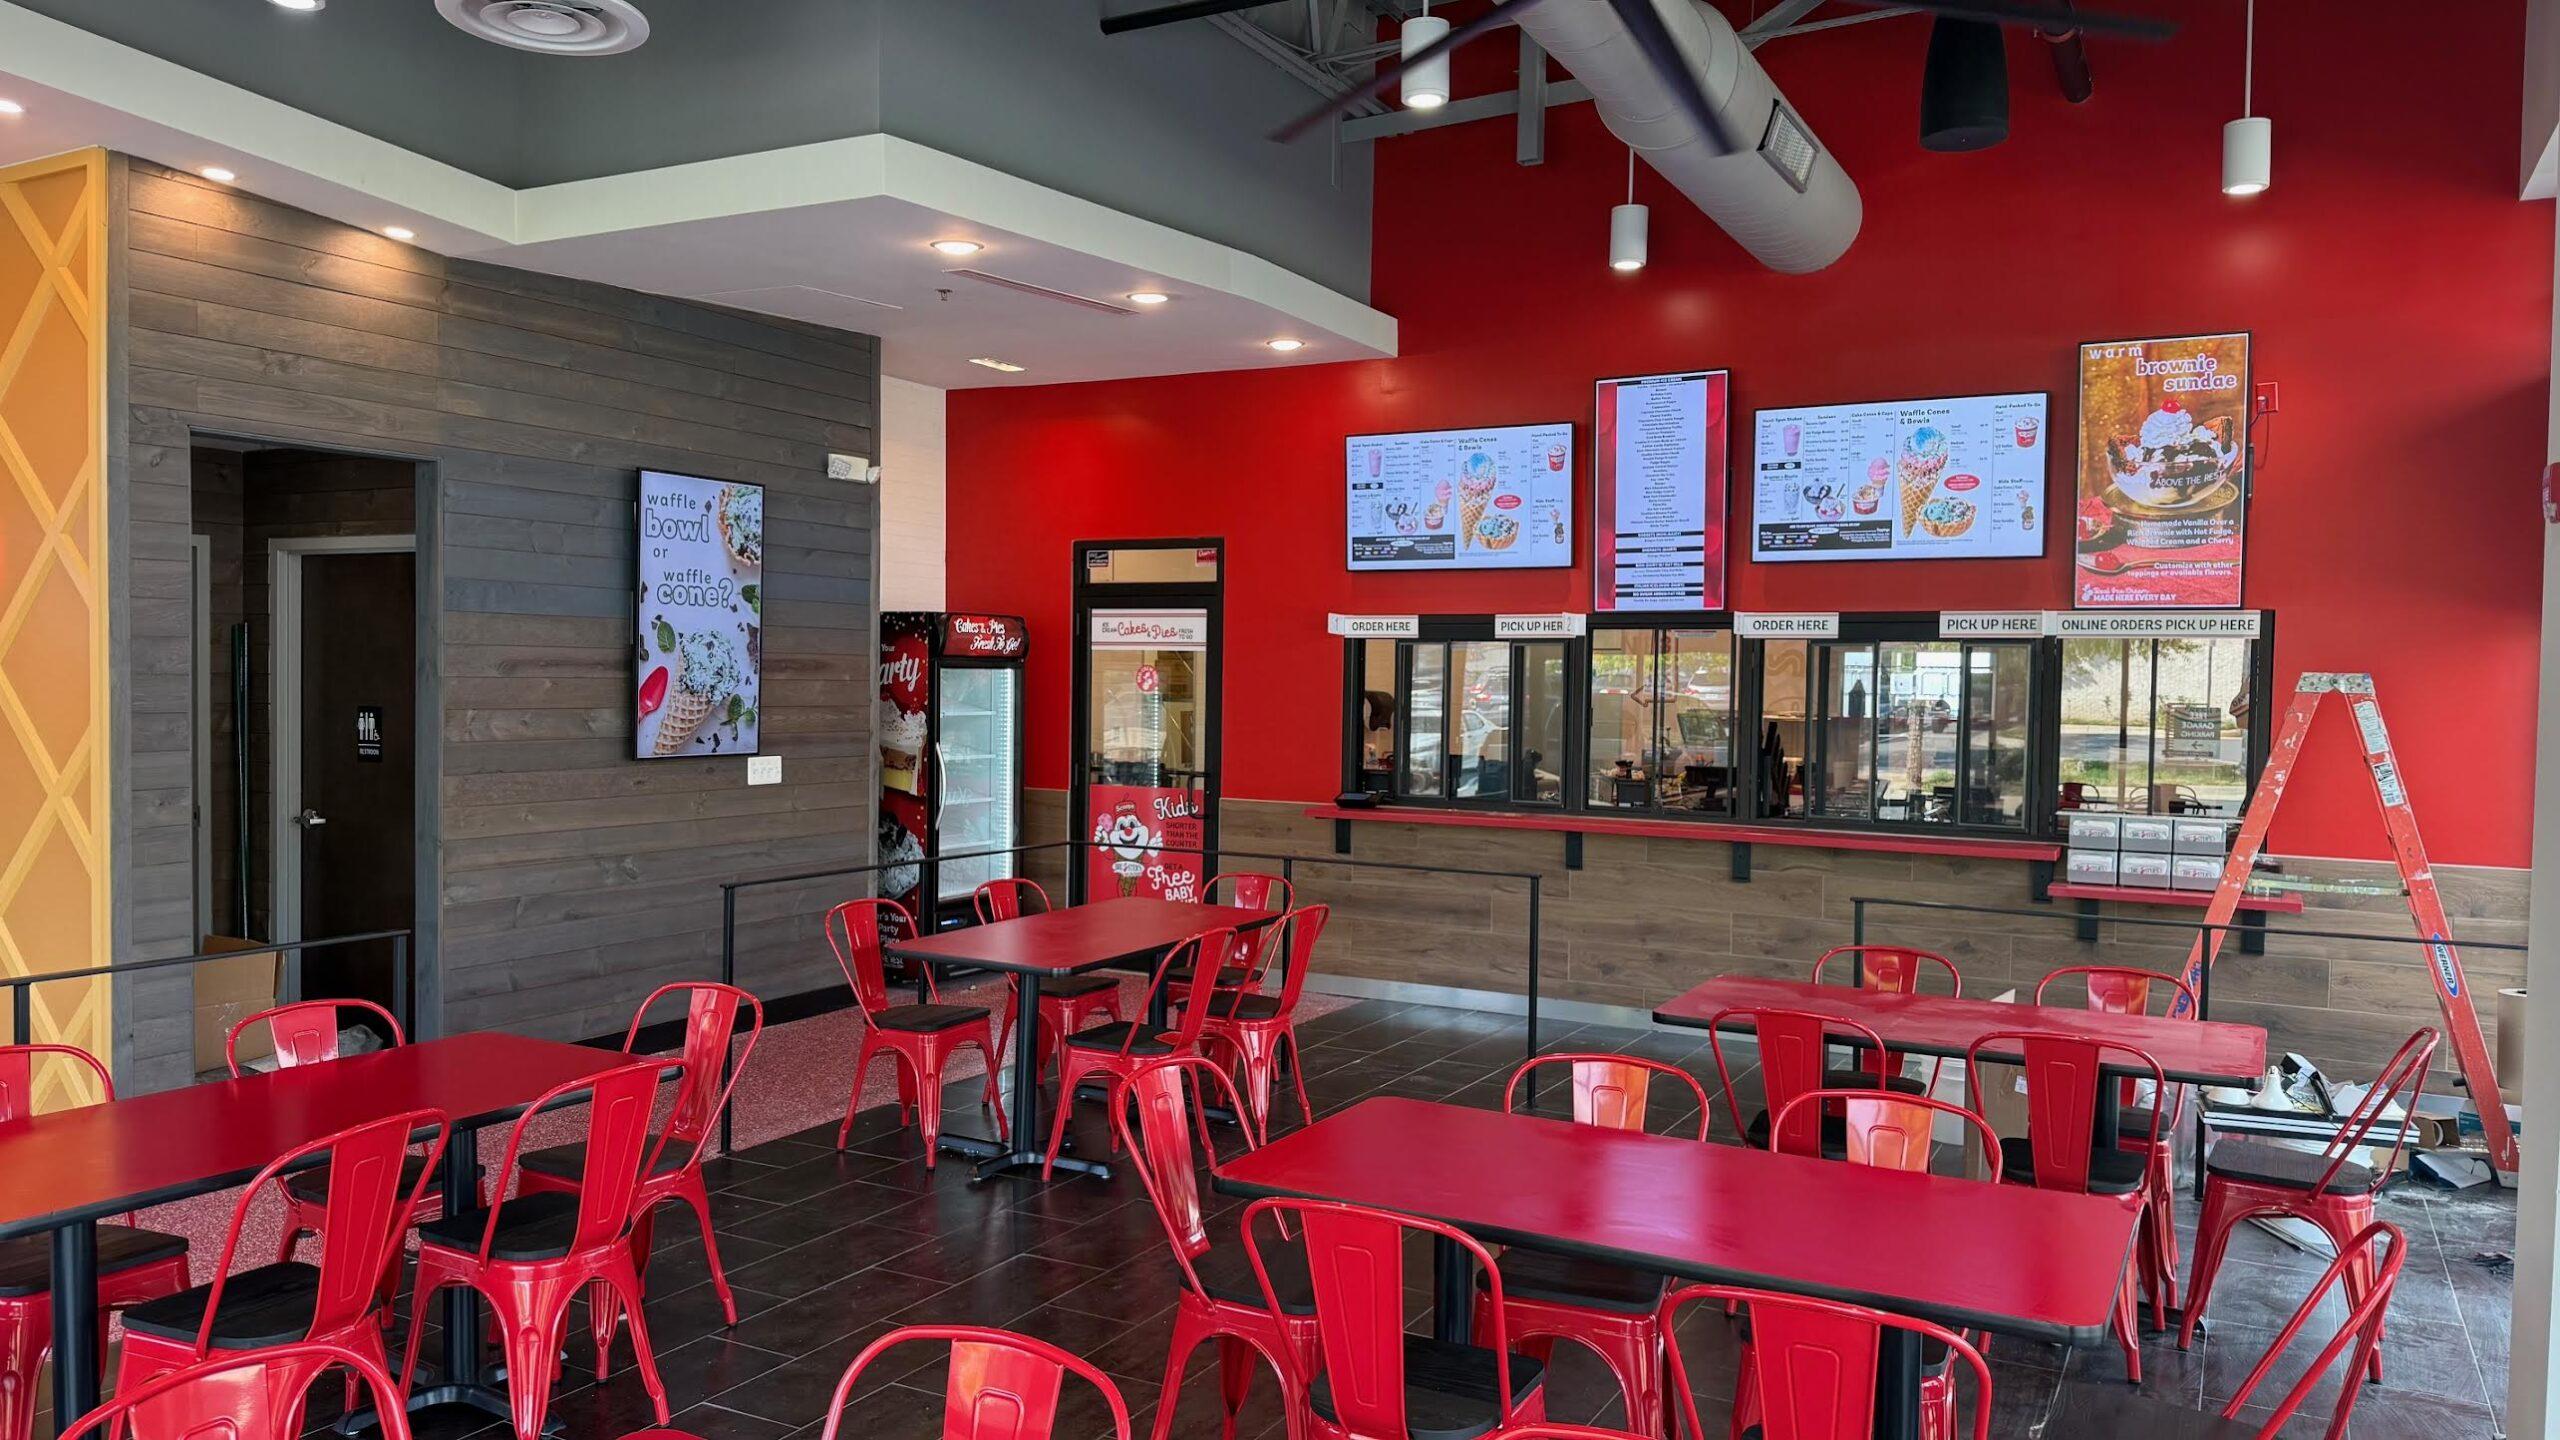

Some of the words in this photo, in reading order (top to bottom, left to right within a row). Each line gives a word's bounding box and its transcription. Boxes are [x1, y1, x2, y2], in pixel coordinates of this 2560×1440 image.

[2089, 346, 2143, 359] warm
[2136, 353, 2217, 376] brownie
[2164, 371, 2238, 392] sundae
[1900, 409, 1925, 418] Waffle
[1926, 408, 1950, 416] Cones
[2155, 475, 2184, 487] ABOVE
[2186, 474, 2202, 485] THE
[2203, 470, 2224, 483] REST
[647, 493, 696, 510] waffle
[645, 508, 710, 543] bowl
[2182, 518, 2209, 527] Vanilla
[2209, 518, 2228, 526] Over
[2175, 528, 2193, 536] with
[2160, 537, 2185, 546] Cream
[2208, 537, 2234, 546] Cherry
[653, 546, 669, 558] or
[2153, 562, 2194, 570] Customize
[2194, 562, 2210, 570] with
[663, 567, 712, 585] waffle
[656, 577, 734, 609] cone?
[2135, 593, 2160, 601] EVERY
[2160, 593, 2177, 601] DAY
[955, 618, 979, 634] Cakes
[986, 618, 1006, 634] Pies
[1117, 620, 1149, 637] Cakes
[1151, 624, 1178, 640] Pies
[1351, 621, 1384, 632] ORDER
[1385, 621, 1411, 632] HERE
[1500, 621, 1526, 632] PICK
[1526, 621, 1542, 632] UP
[1542, 621, 1563, 632] HER
[1752, 620, 1794, 631] ORDER
[1797, 620, 1829, 631] HERE
[1947, 619, 1978, 630] PICK
[1981, 619, 1999, 630] UP
[2002, 619, 2038, 630] HERE
[2061, 619, 2108, 631] ONLINE
[2110, 619, 2163, 631] ORDERS
[2165, 619, 2196, 631] PICK
[2199, 619, 2217, 630] UP
[2220, 619, 2255, 630] HERE
[881, 643, 896, 652] Your
[970, 636, 994, 651] Fresh
[993, 634, 1005, 650] To
[880, 652, 922, 692] arty
[1165, 822, 1197, 830] SHORTER
[1166, 831, 1184, 839] THAN
[1165, 840, 1197, 848] COUNTER
[1147, 865, 1195, 890] Free
[1164, 884, 1195, 902] BABY
[890, 912, 907, 922] Your
[878, 924, 899, 936] Party
[2435, 944, 2456, 987] WERNER
